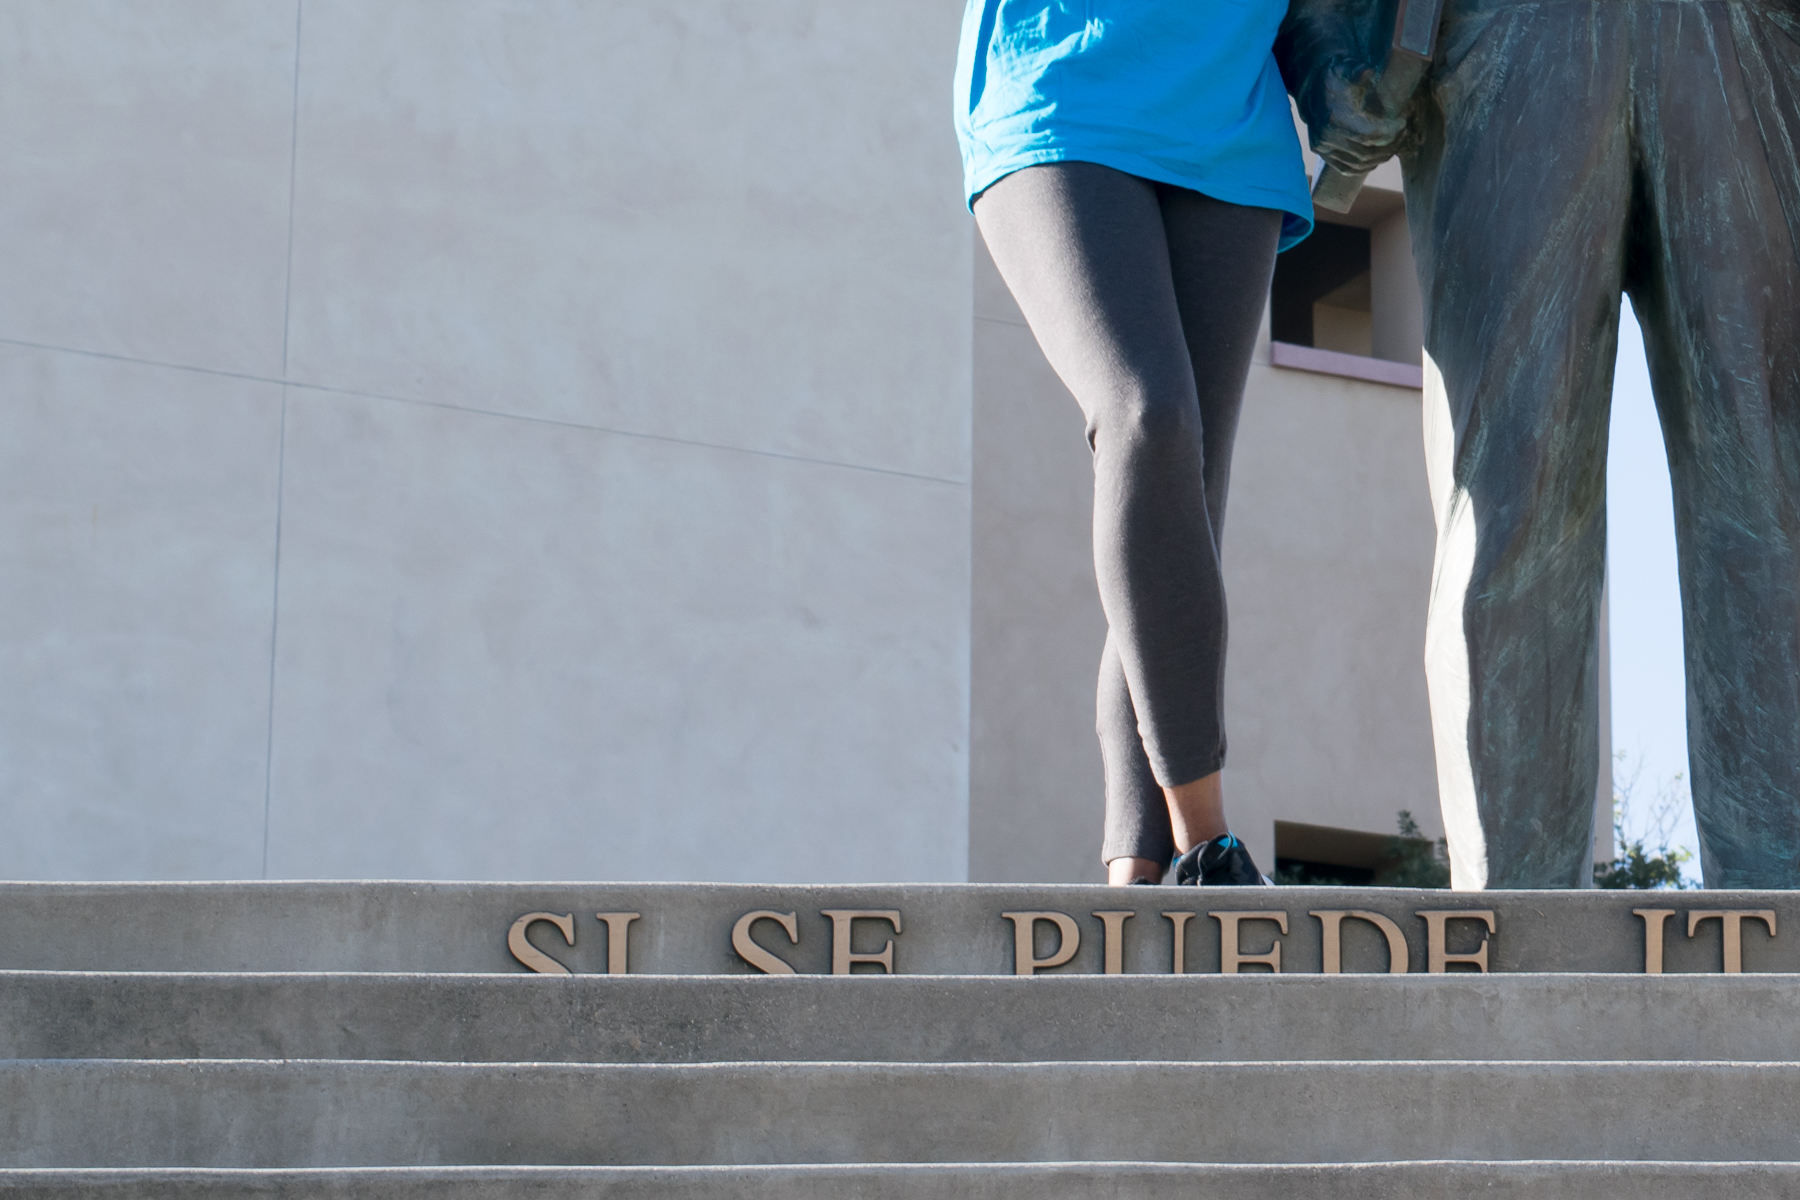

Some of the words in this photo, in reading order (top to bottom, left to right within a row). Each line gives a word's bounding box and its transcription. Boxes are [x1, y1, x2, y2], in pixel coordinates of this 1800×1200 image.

[507, 911, 641, 974] SI
[732, 909, 901, 974] SE
[1001, 909, 1497, 974] PUEDE
[1632, 908, 1777, 974] IT
